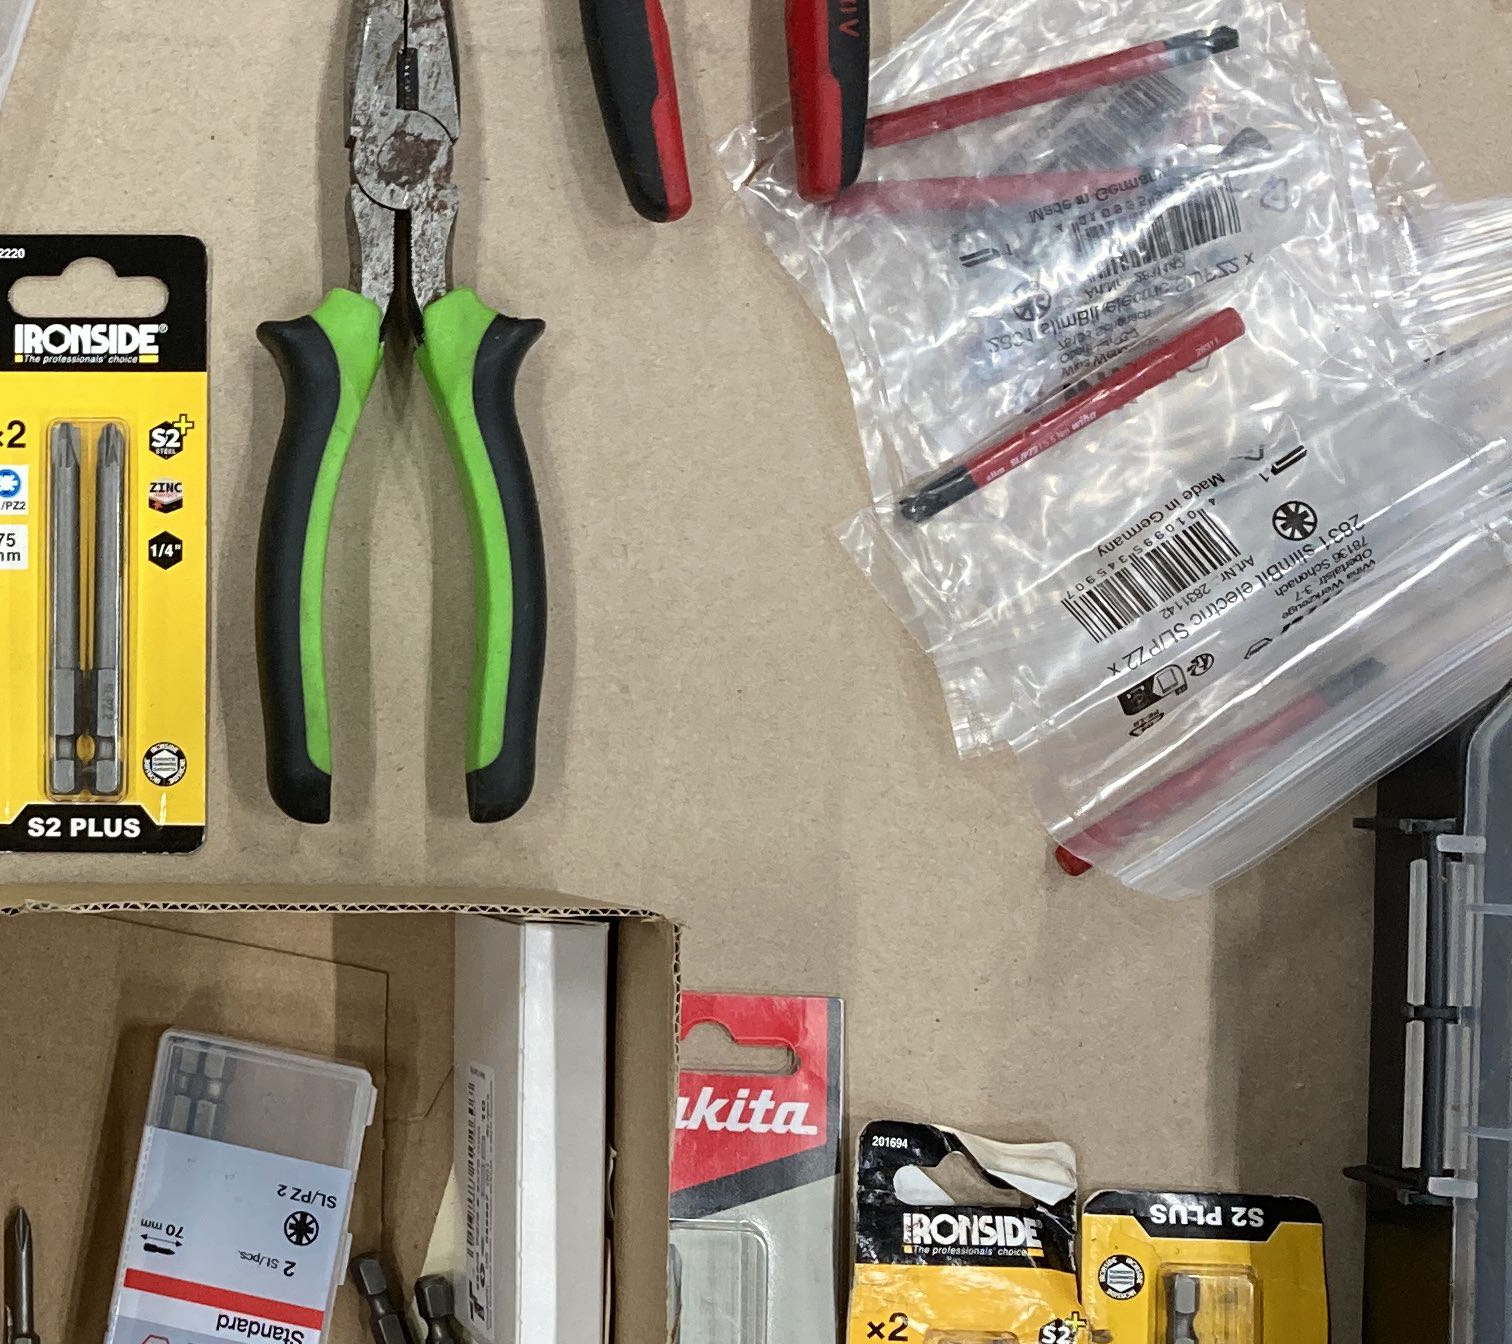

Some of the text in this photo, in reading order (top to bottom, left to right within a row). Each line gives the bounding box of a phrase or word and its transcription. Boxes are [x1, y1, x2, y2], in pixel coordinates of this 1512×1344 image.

[24, 354, 40, 363] The
[108, 354, 138, 364] choice
[149, 481, 182, 494] ZINC
[1096, 472, 1226, 558] Made in Germany
[1322, 513, 1368, 552] 2831
[1193, 580, 1254, 628] electric
[1106, 661, 1121, 677] x
[27, 817, 141, 838] S2 PLUS
[872, 1135, 908, 1149] 201694
[278, 1183, 338, 1209] 2 SL/PZ
[1149, 1204, 1265, 1228] PLUS S2
[141, 1218, 296, 1277] mm 70 2
[913, 1245, 930, 1255] The
[997, 1247, 1026, 1257] choice
